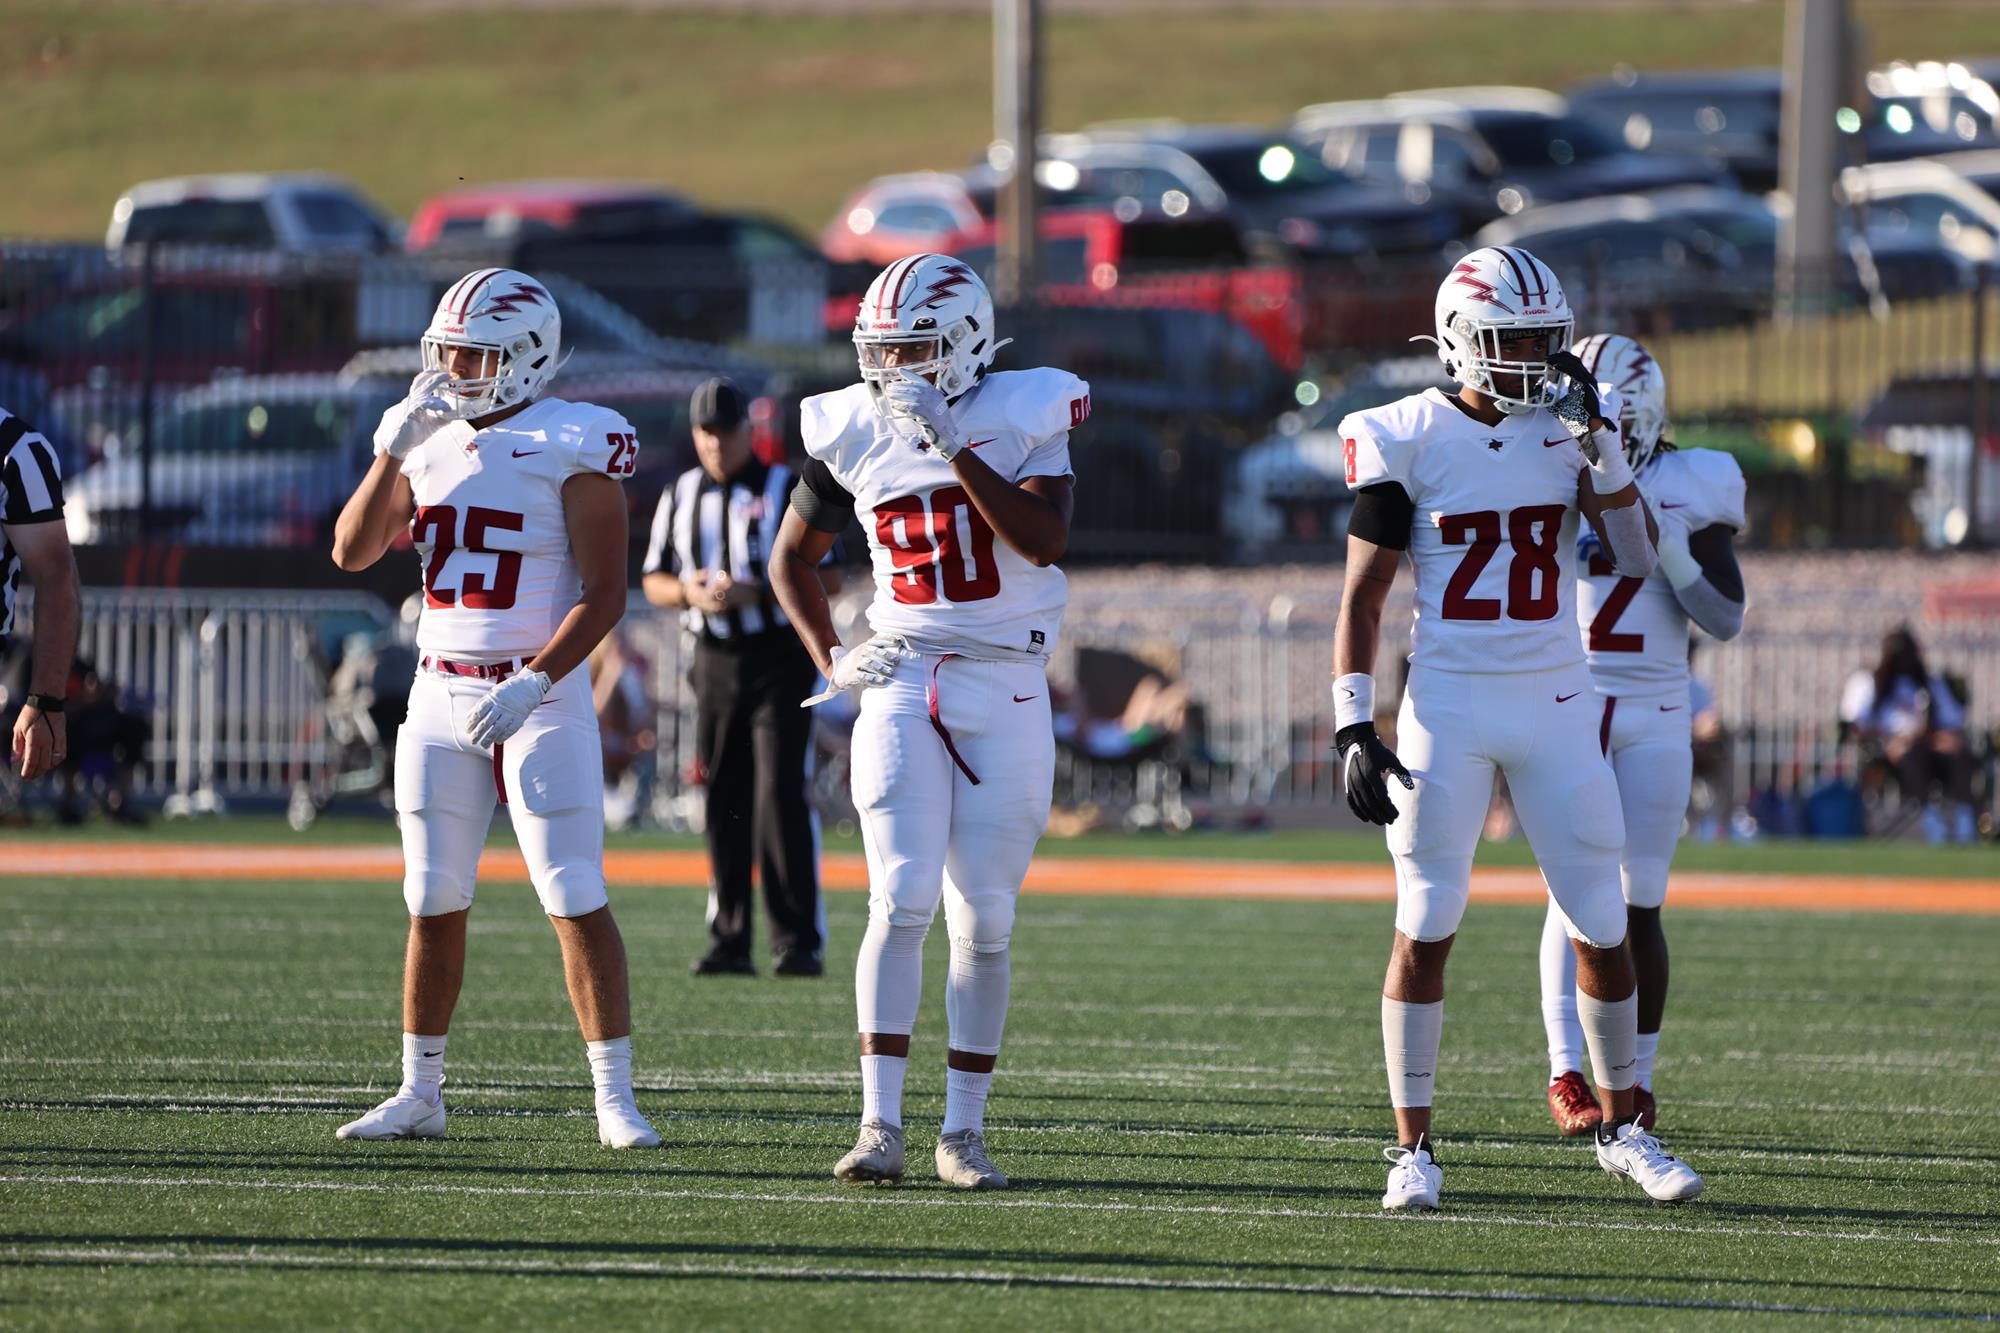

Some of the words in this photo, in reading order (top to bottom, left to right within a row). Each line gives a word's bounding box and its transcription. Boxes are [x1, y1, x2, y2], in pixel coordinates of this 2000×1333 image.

[606, 433, 636, 473] 25
[1343, 438, 1357, 483] 8
[413, 505, 523, 609] 25
[872, 485, 1000, 604] 90
[1439, 504, 1567, 620] 28
[1589, 550, 1644, 652] 2
